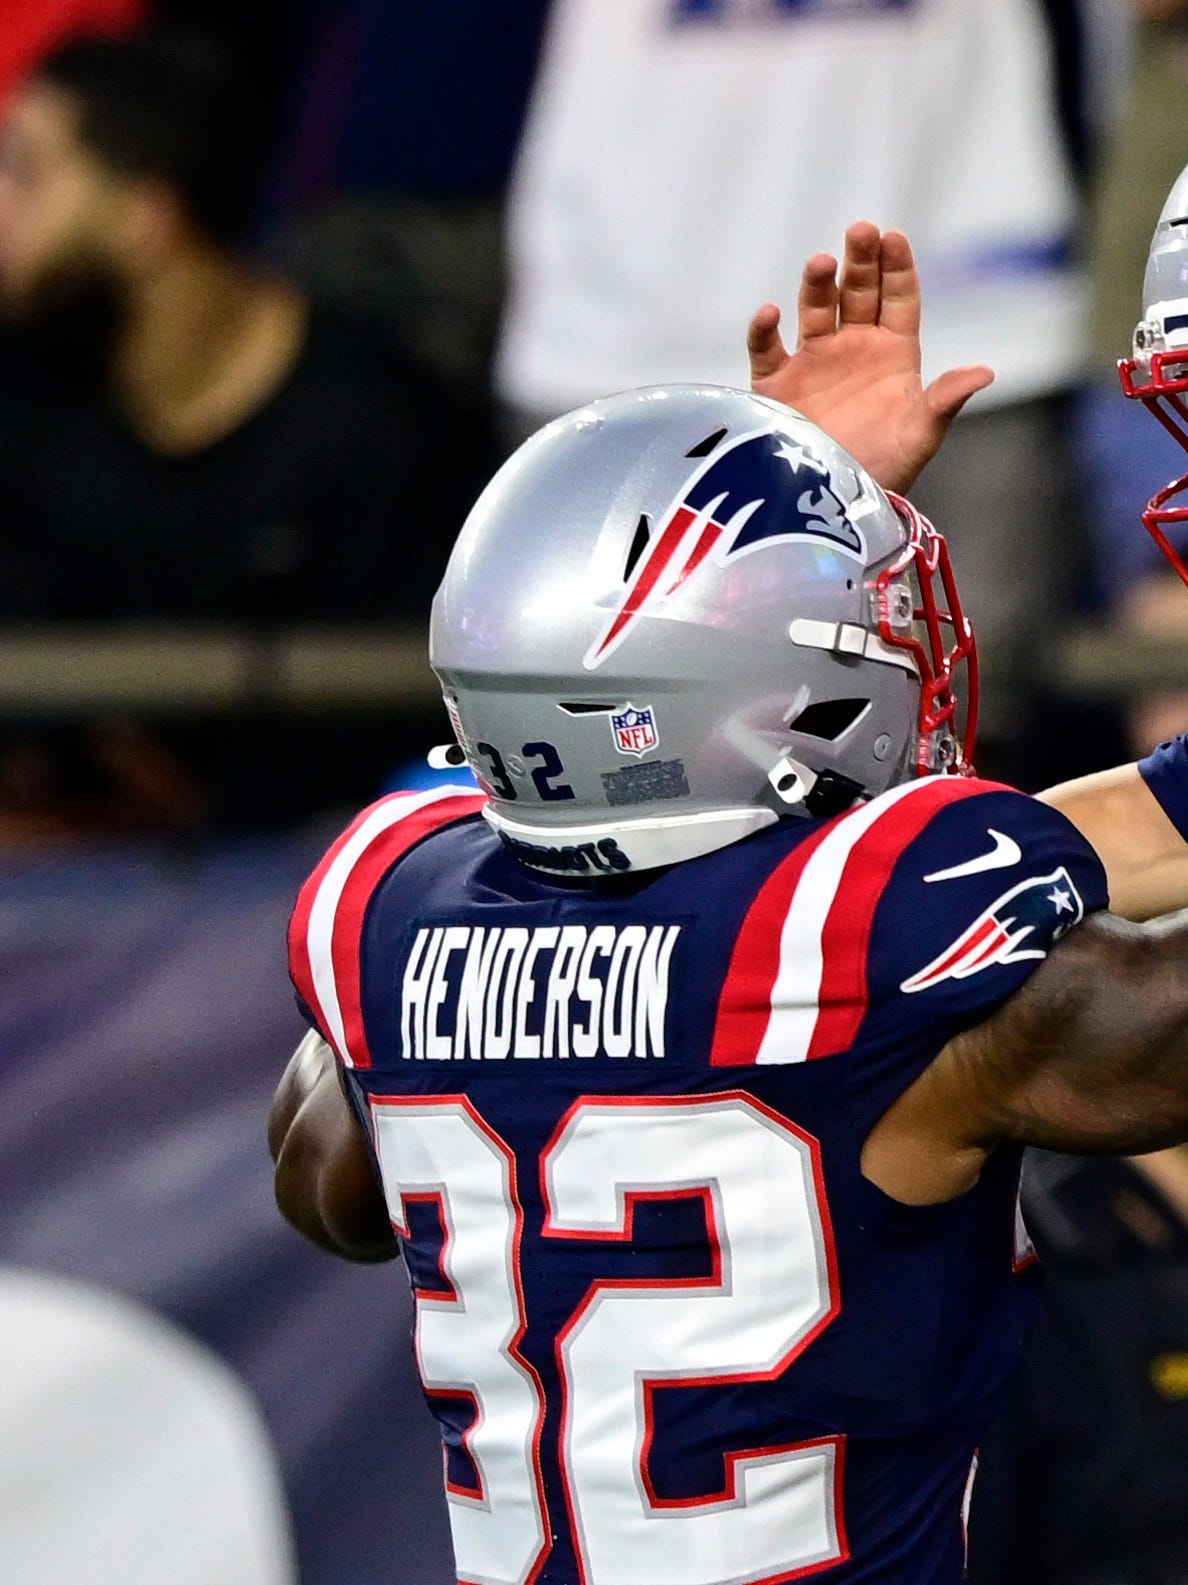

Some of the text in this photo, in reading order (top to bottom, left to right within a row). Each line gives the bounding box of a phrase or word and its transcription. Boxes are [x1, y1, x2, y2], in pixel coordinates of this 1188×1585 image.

[477, 741, 575, 801] 32
[619, 727, 653, 749] NFL
[401, 925, 681, 1060] HENDERSON
[368, 1089, 851, 1585] 32
